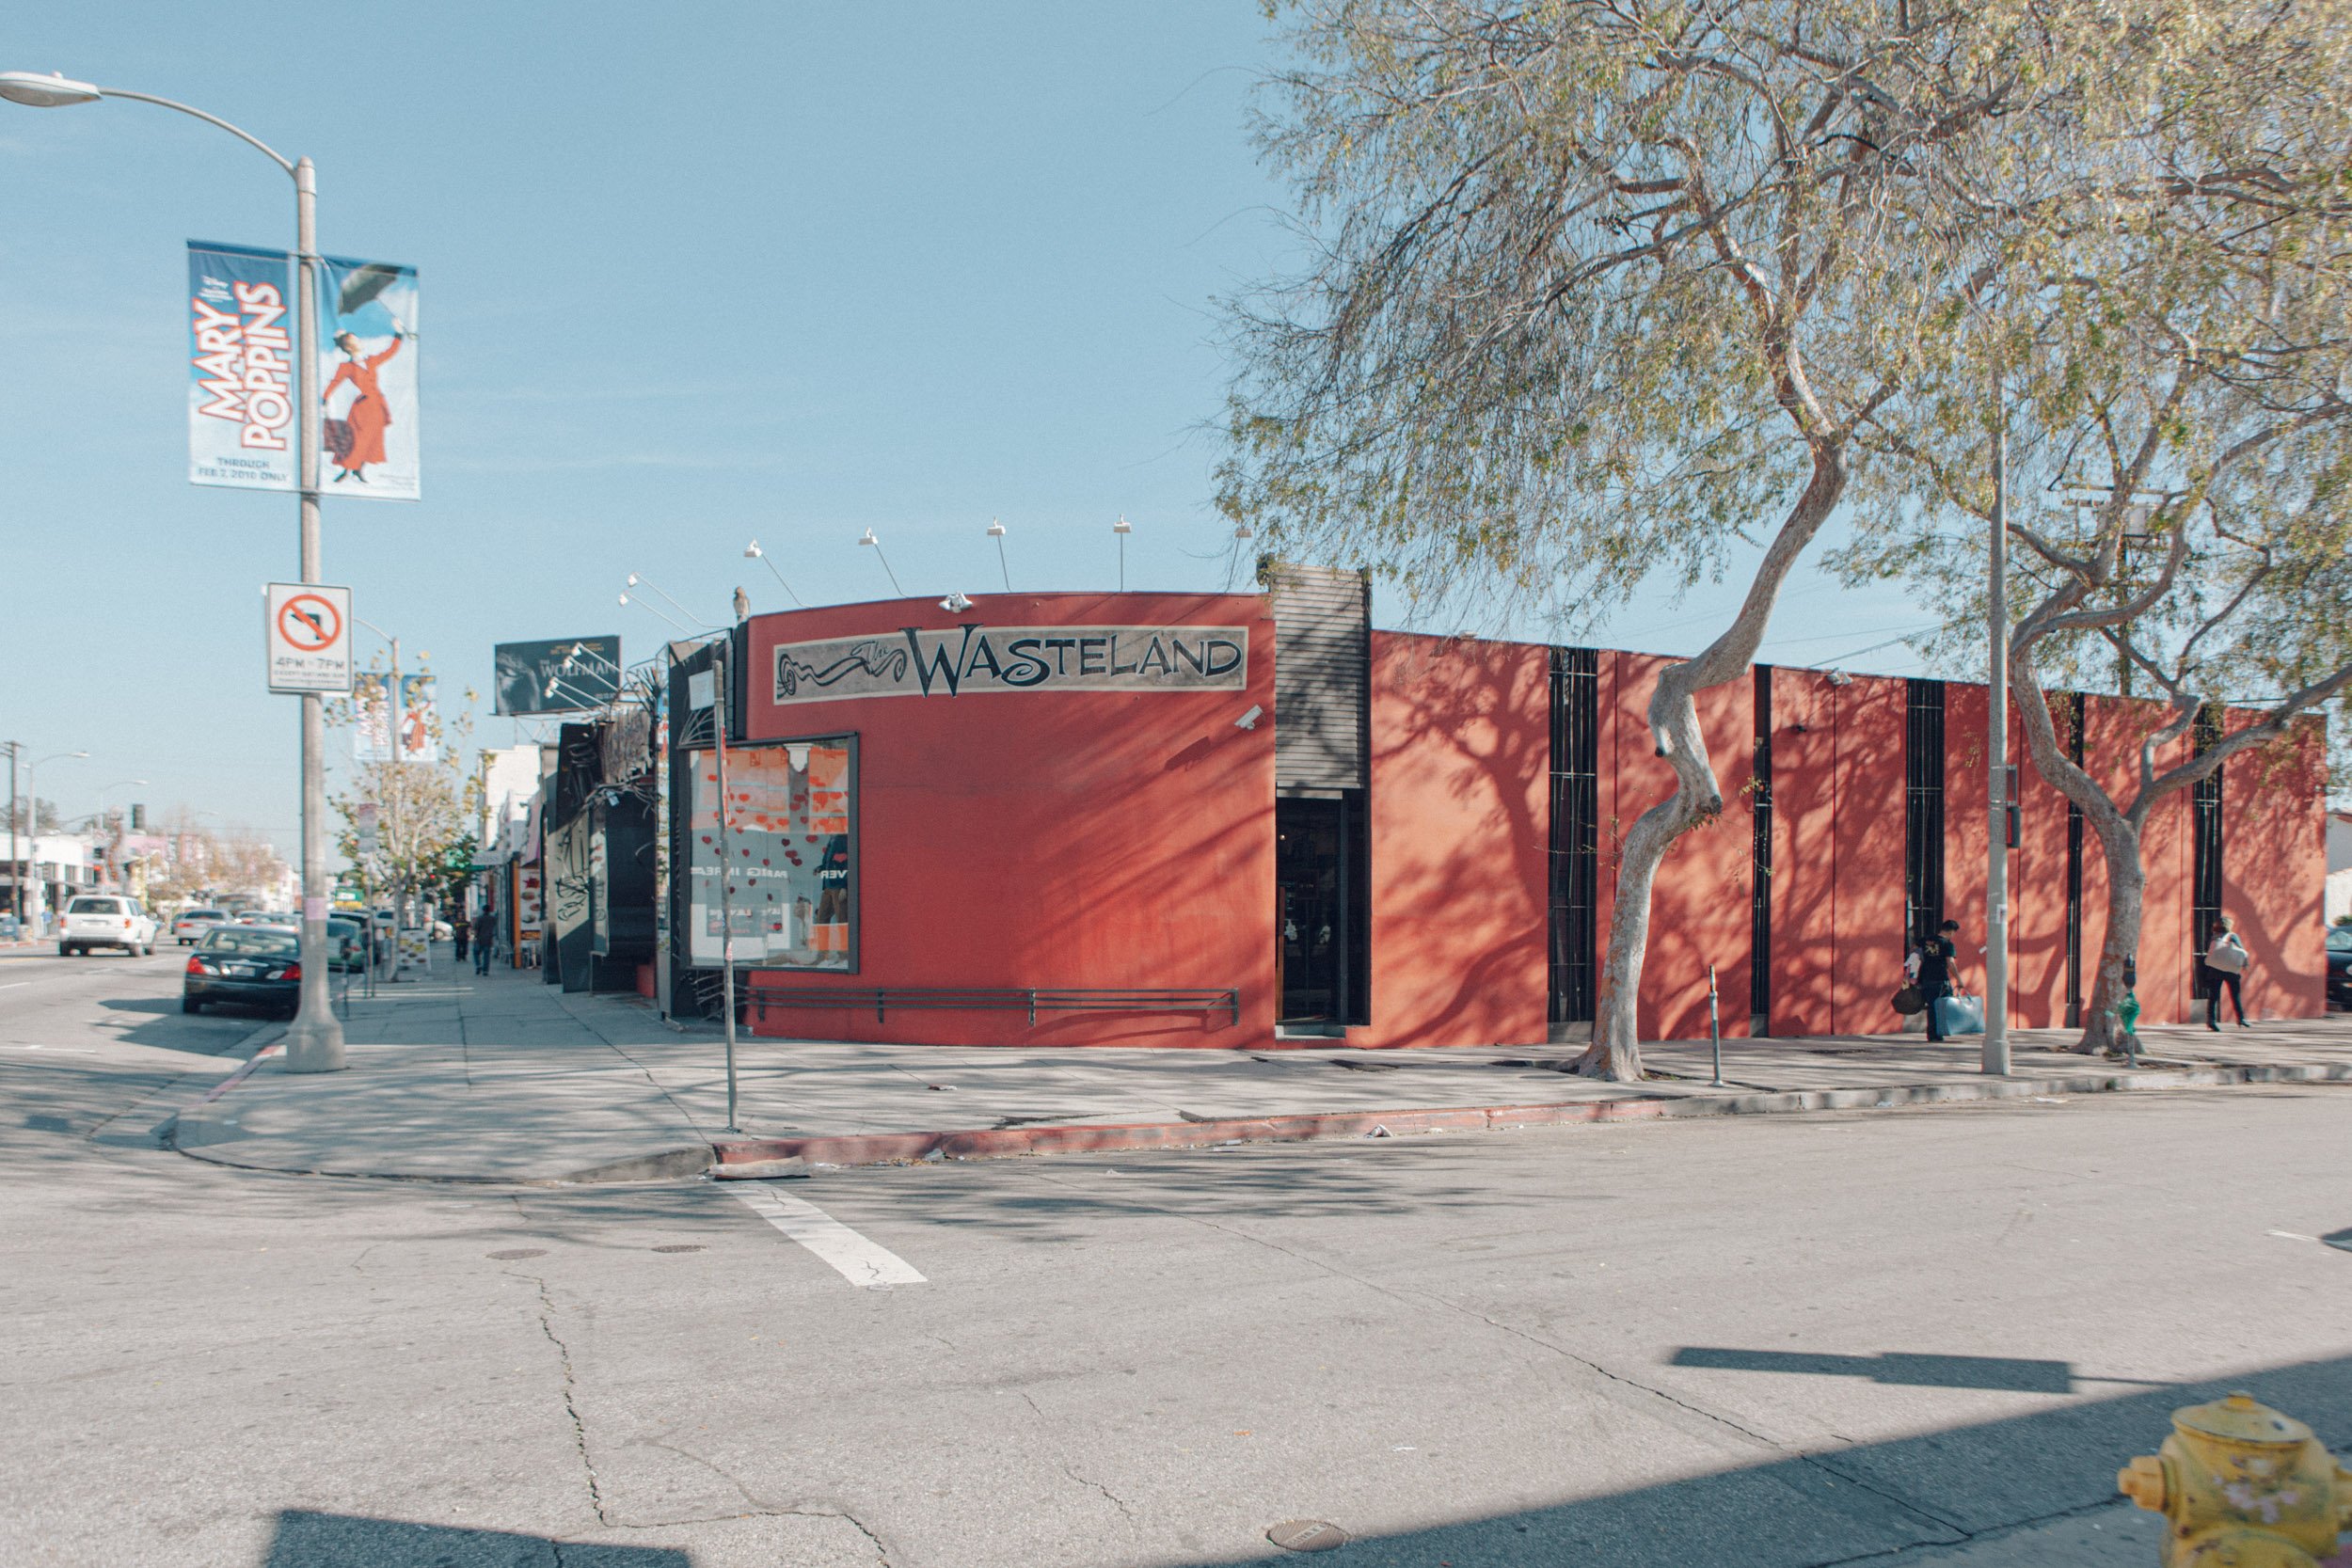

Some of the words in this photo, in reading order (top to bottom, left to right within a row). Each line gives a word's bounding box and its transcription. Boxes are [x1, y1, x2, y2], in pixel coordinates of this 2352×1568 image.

[193, 297, 246, 422] MARY
[233, 280, 291, 451] POPPINS
[216, 457, 271, 468] THROUGH
[260, 471, 289, 482] ONLY
[276, 657, 305, 669] 4PM
[317, 657, 346, 671] 7PM
[898, 623, 1243, 699] WASTELAND
